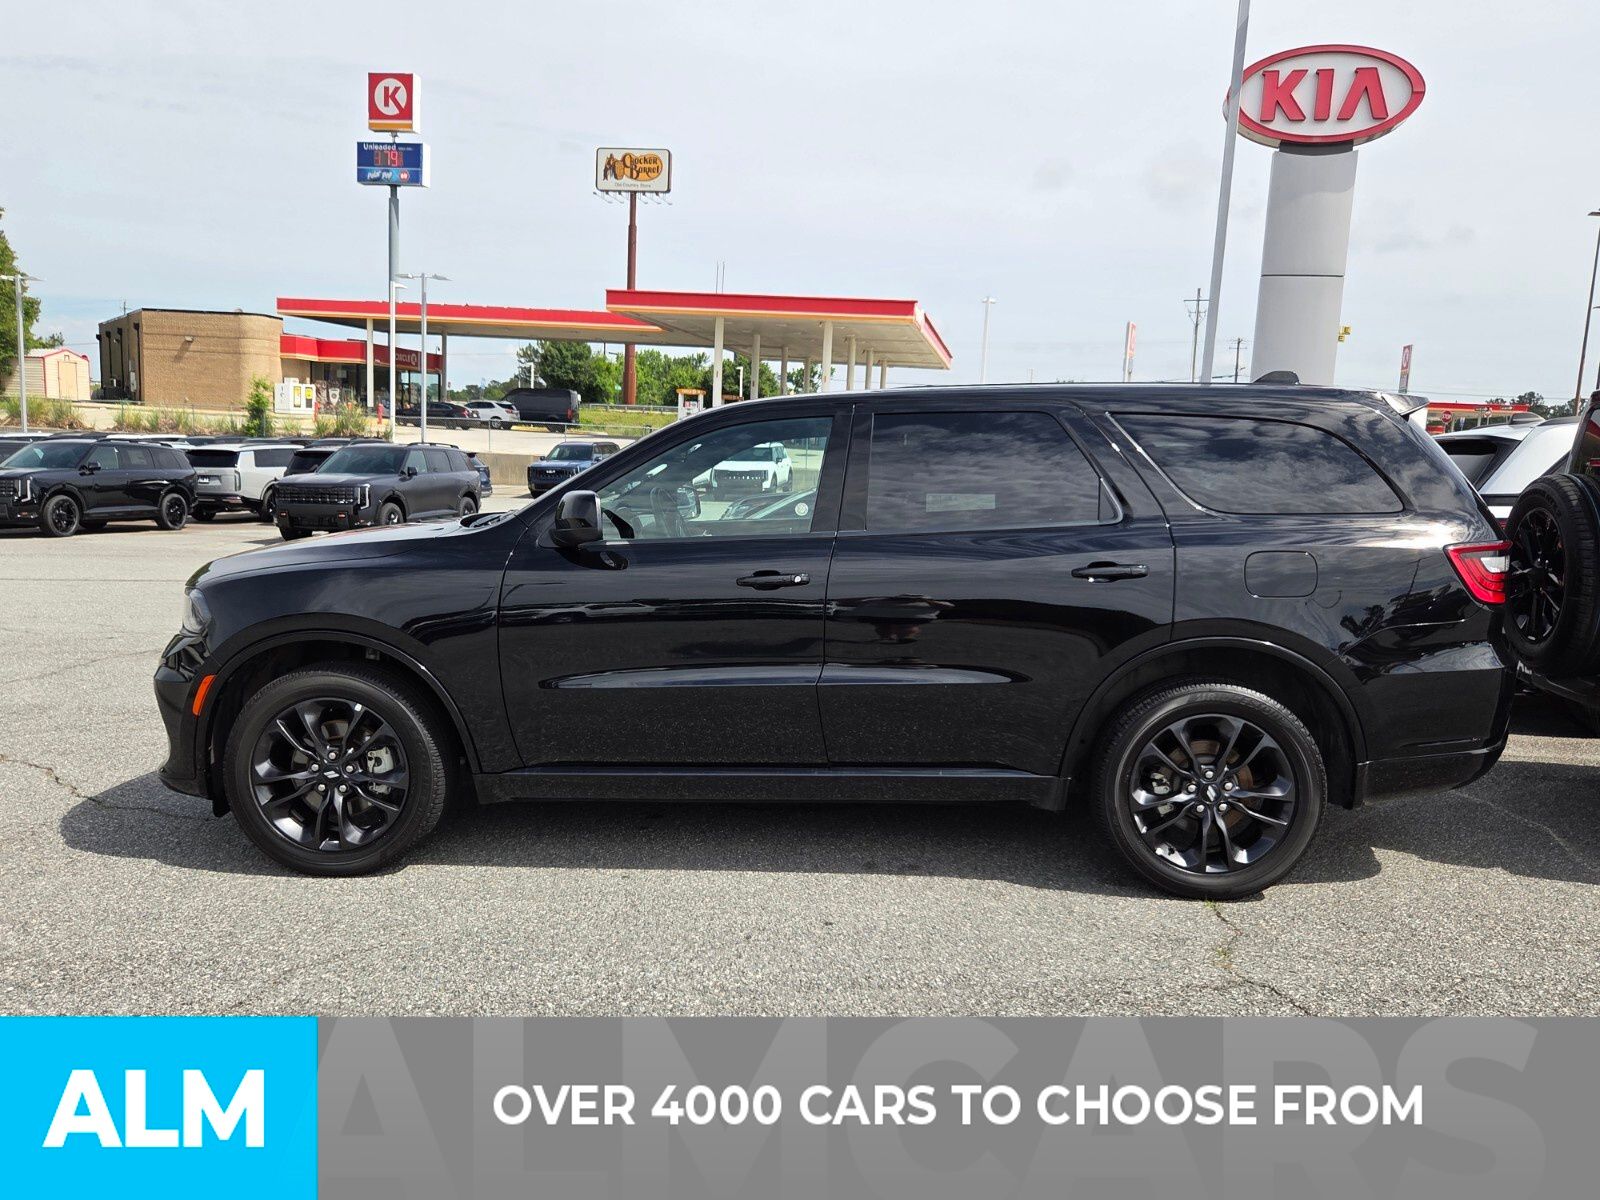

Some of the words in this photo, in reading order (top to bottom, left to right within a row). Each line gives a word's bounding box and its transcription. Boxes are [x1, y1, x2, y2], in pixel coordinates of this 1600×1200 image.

[382, 85, 405, 115] K
[1260, 67, 1389, 122] KIA
[363, 142, 397, 151] Unleaded
[621, 153, 658, 169] Cracker
